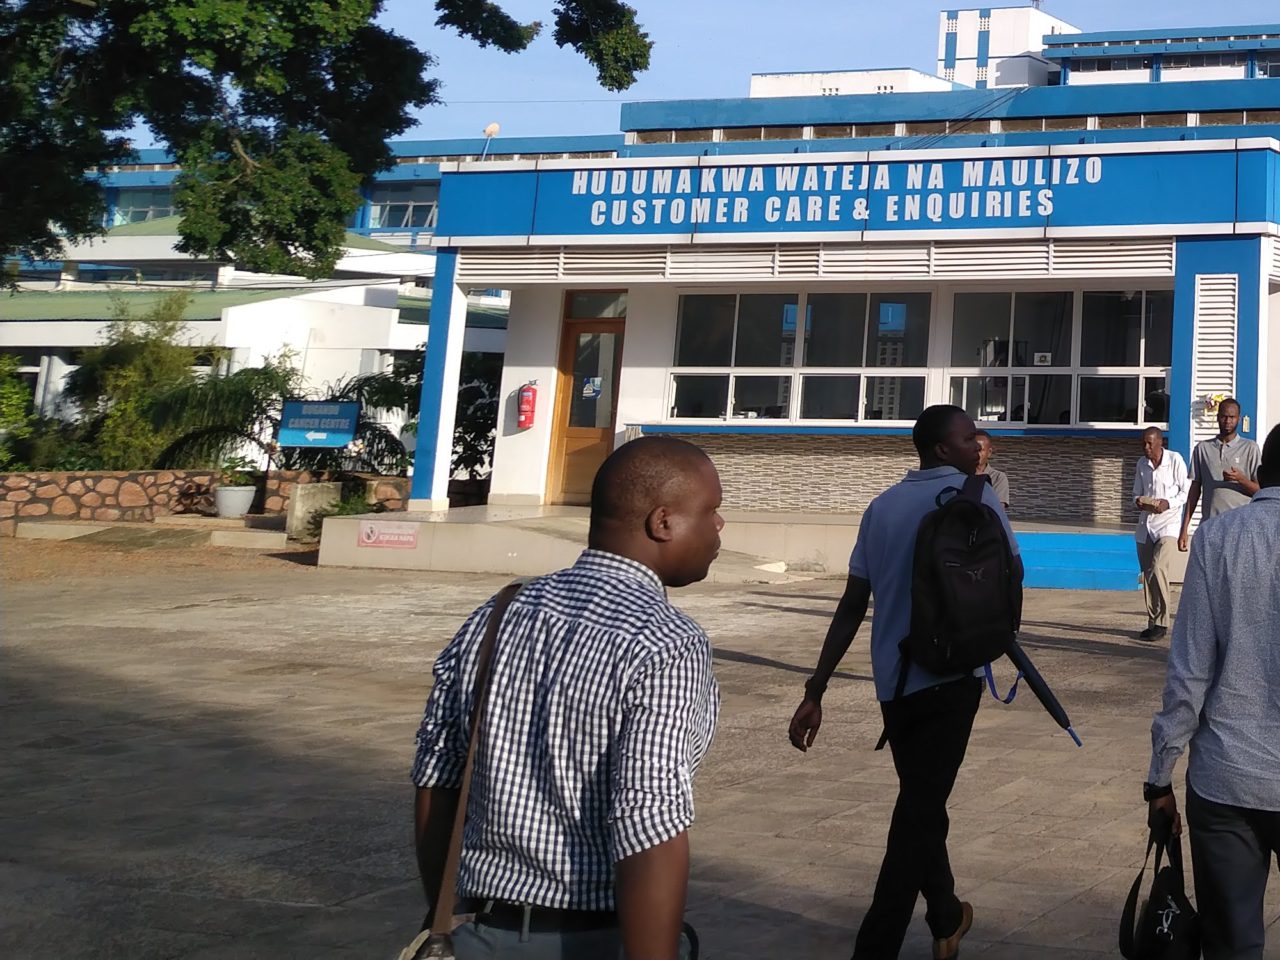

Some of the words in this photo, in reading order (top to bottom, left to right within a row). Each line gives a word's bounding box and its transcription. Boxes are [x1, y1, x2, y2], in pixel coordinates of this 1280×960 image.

[572, 168, 692, 195] HUDUMA
[700, 166, 764, 193] KWA
[775, 164, 890, 192] WATEJA
[906, 163, 944, 190] NA
[962, 156, 1102, 187] MAULIZO
[590, 197, 749, 226] CUSTOMER
[764, 195, 841, 223] CARE
[852, 197, 870, 220] &
[886, 188, 1054, 222] ENQUIRIES
[320, 418, 350, 429] CENTRE
